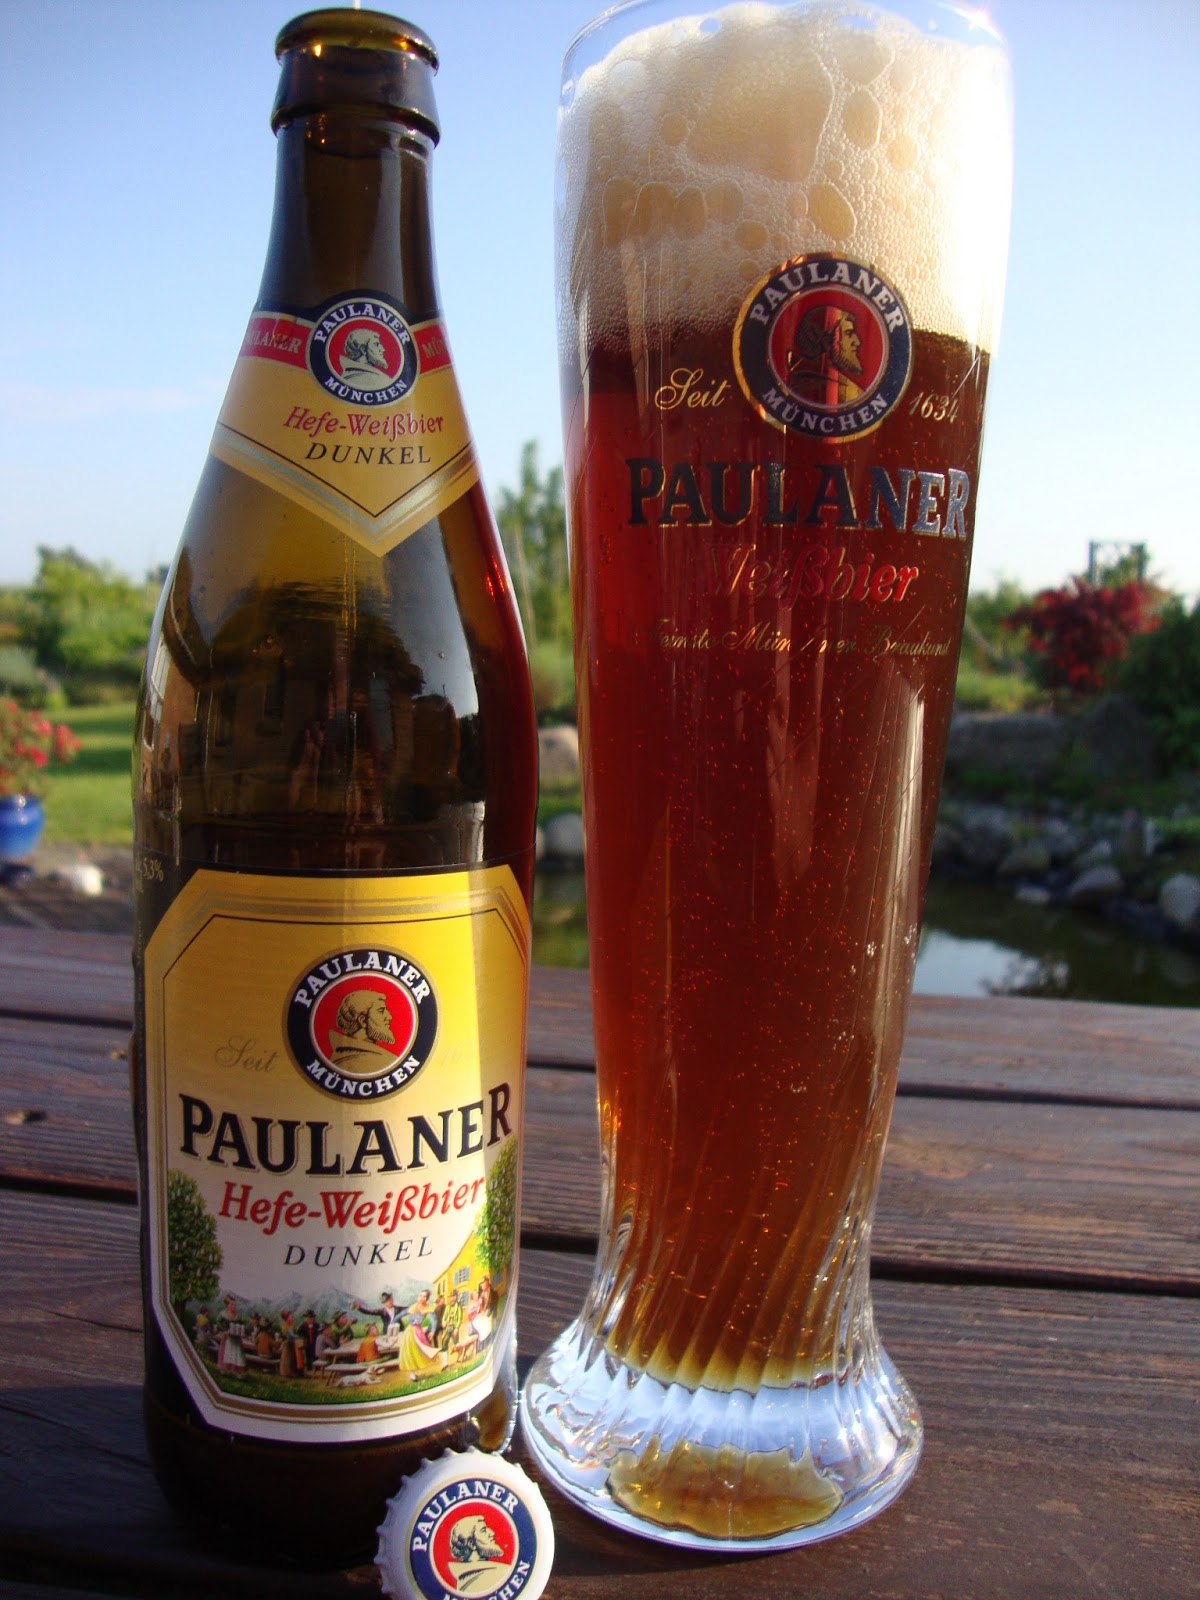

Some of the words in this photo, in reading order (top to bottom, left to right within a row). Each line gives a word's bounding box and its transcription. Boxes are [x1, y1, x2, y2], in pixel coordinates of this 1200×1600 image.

[750, 261, 905, 333] PAULANER
[314, 303, 410, 346] PAULANER
[325, 377, 408, 403] MÜNCHEN
[654, 367, 731, 410] Seit
[909, 391, 959, 424] 1634
[762, 387, 889, 434] MÜNCHEN
[283, 406, 444, 442] Hefe-Weißbier
[305, 442, 431, 465] DUNKEL
[626, 457, 970, 541] PAULANER
[295, 951, 431, 1009] PAULANER
[306, 1055, 421, 1097] MÜNCHEN
[179, 1082, 512, 1177] PAULANER
[218, 1175, 486, 1236] Hefe-Weißbier
[284, 1236, 434, 1268] DUNKEL
[413, 1481, 519, 1552] PAULANER
